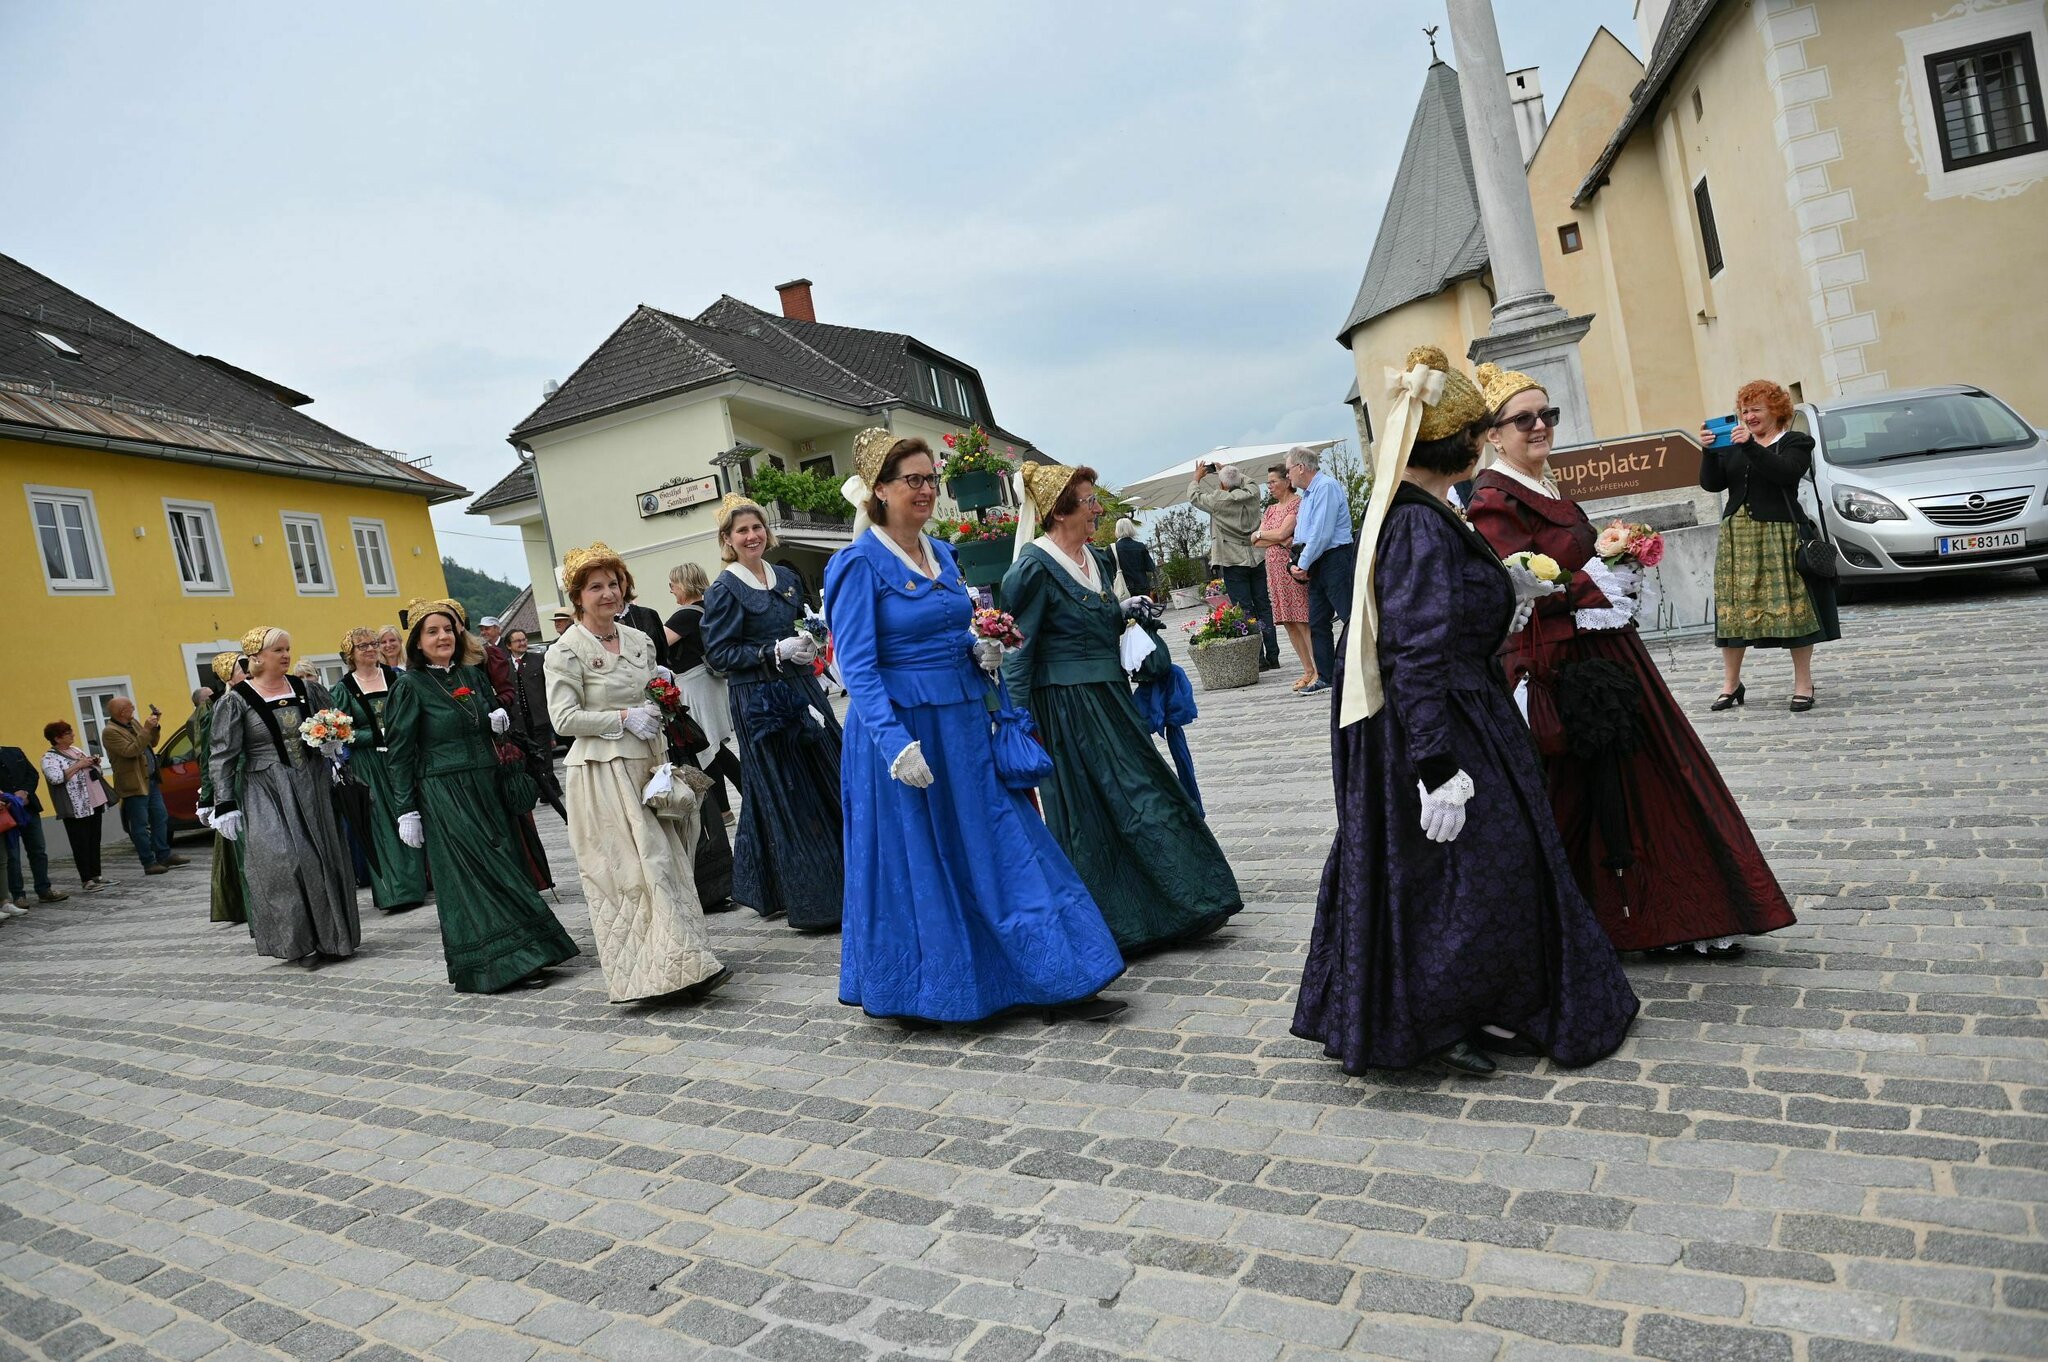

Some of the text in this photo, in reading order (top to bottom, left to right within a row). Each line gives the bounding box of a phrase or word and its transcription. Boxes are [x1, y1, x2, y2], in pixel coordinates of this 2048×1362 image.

[1552, 446, 1668, 486] auptplatz 7
[1570, 479, 1640, 496] DAS KAFFEEHAUS
[1952, 538, 1967, 551] KL
